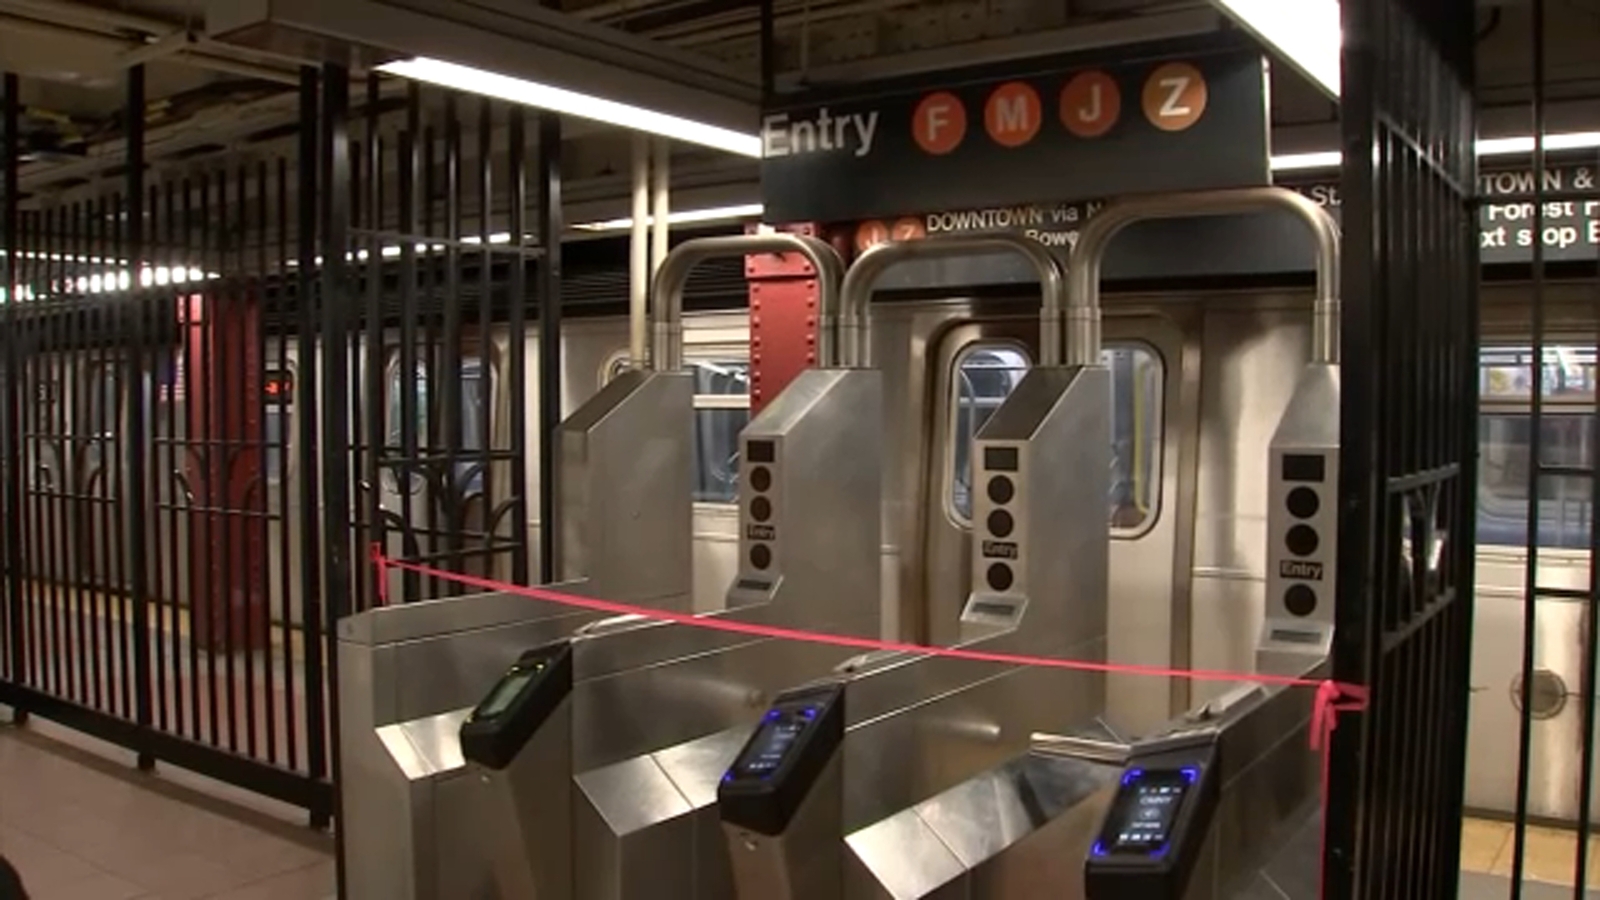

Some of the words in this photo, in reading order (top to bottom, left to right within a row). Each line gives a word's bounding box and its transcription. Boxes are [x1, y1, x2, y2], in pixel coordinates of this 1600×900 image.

[763, 107, 878, 158] Entry
[927, 105, 950, 142] F
[995, 95, 1029, 132] M
[1078, 84, 1101, 122] J
[1159, 77, 1191, 117] Z
[1480, 168, 1562, 195] TOWN
[1573, 167, 1594, 189] &
[926, 206, 1043, 232] DOWNTOWN
[1051, 203, 1079, 223] via
[1480, 226, 1506, 248] xt
[1516, 226, 1577, 248] sop
[748, 525, 775, 540] Entry
[983, 541, 1017, 559] Entry
[1281, 561, 1322, 579] Entry
